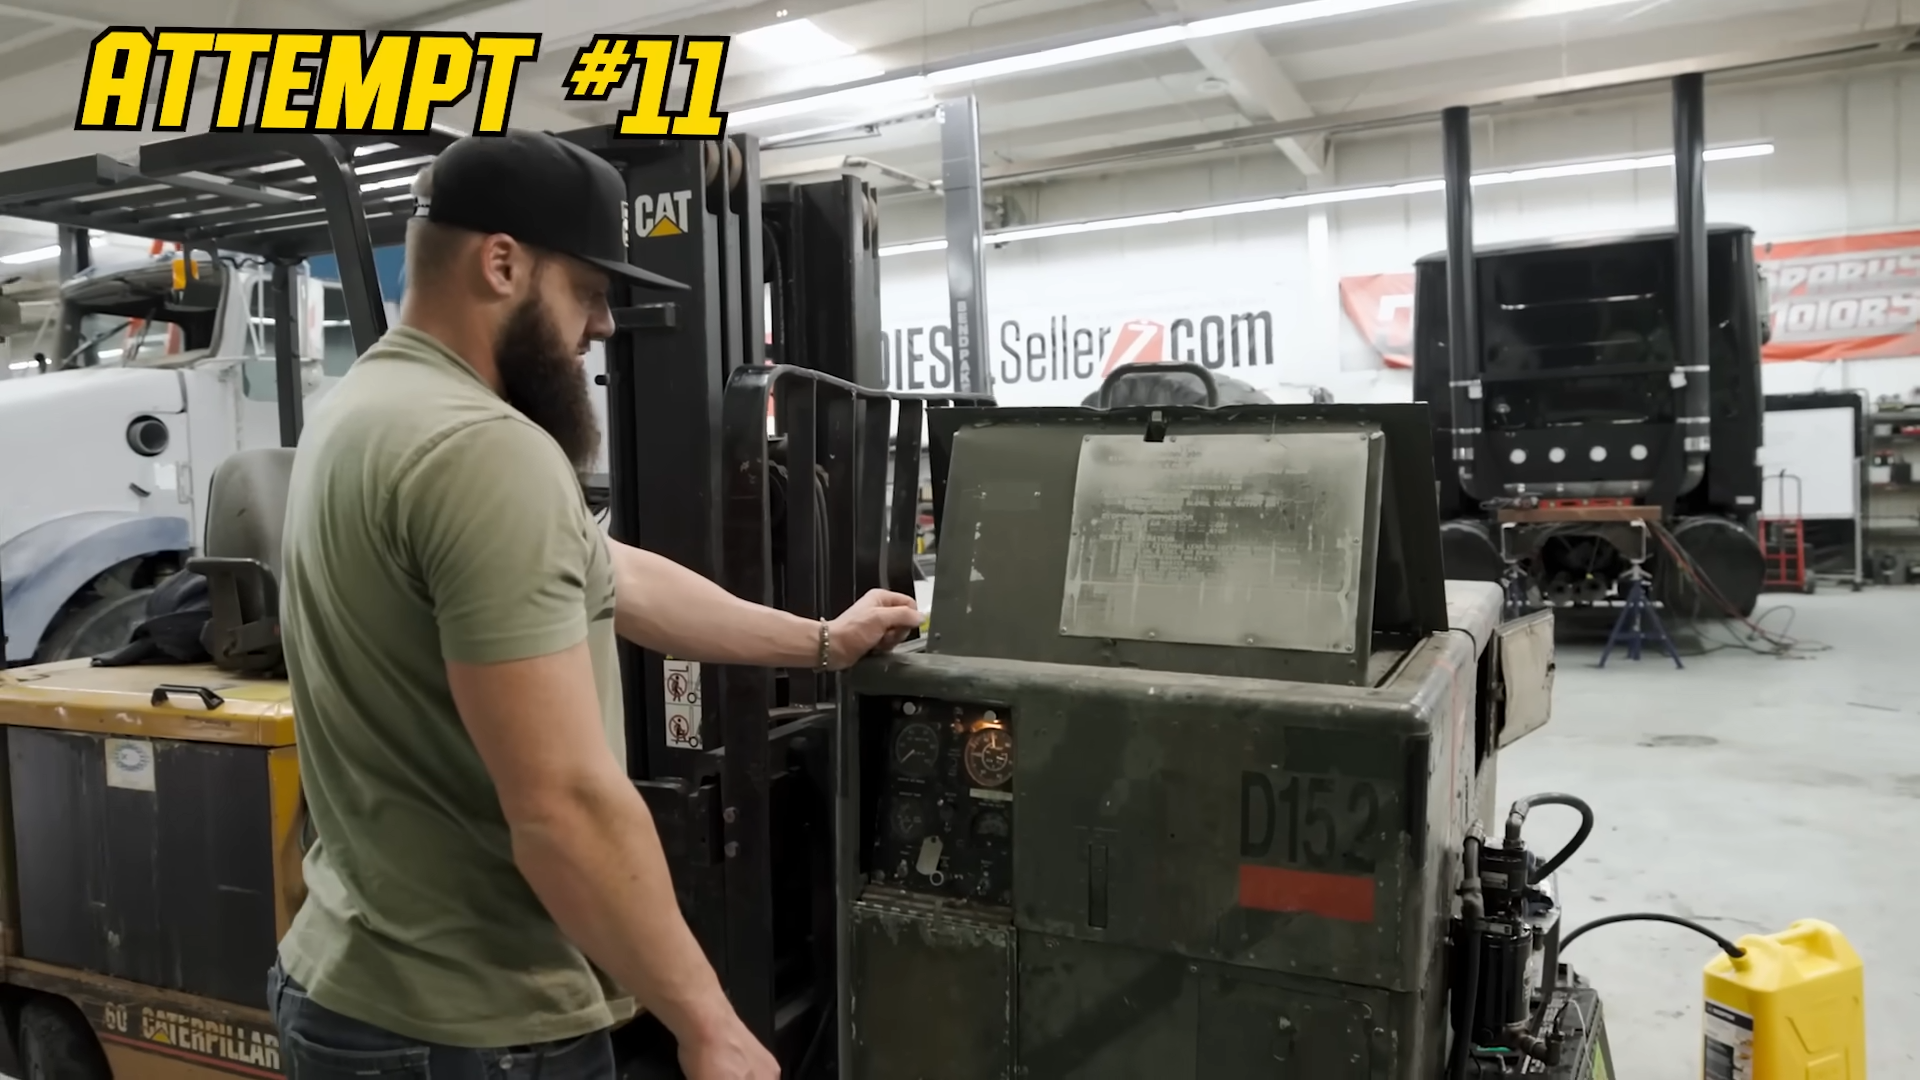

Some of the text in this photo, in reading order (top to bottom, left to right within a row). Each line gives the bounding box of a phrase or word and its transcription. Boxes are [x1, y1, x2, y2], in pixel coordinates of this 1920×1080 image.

[634, 189, 693, 239] CAT
[1239, 770, 1379, 874] D152
[141, 1006, 281, 1070] CATERPILLAR
